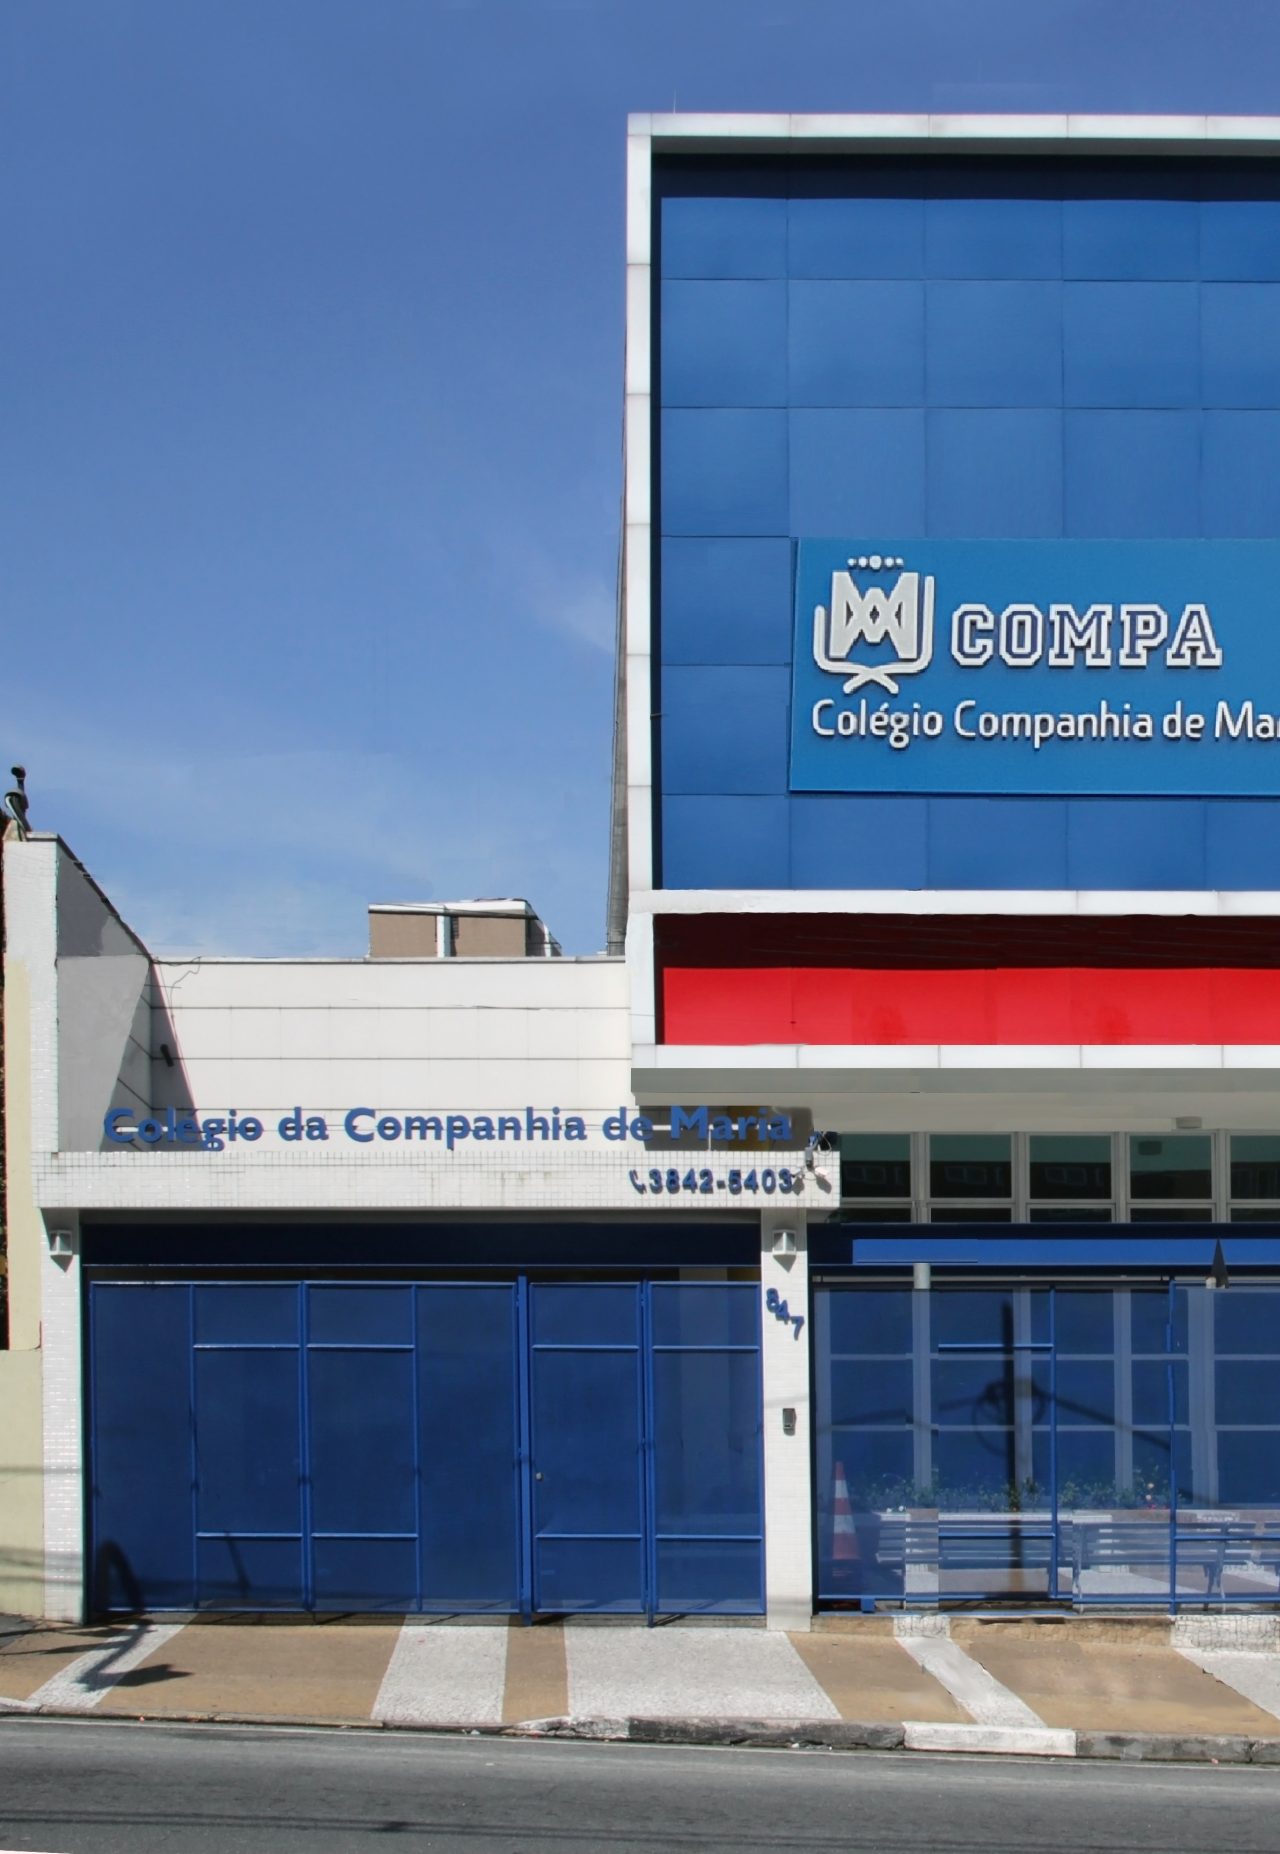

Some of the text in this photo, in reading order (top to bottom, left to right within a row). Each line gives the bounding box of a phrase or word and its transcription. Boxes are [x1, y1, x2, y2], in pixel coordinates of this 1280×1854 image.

[951, 603, 1223, 668] COMPA
[811, 699, 944, 750] Colégio
[953, 699, 1155, 750] Companhia
[1162, 699, 1205, 740] de
[103, 1105, 794, 1152] Colégio da Companhia de Maria
[648, 1167, 795, 1196] 3842-5403
